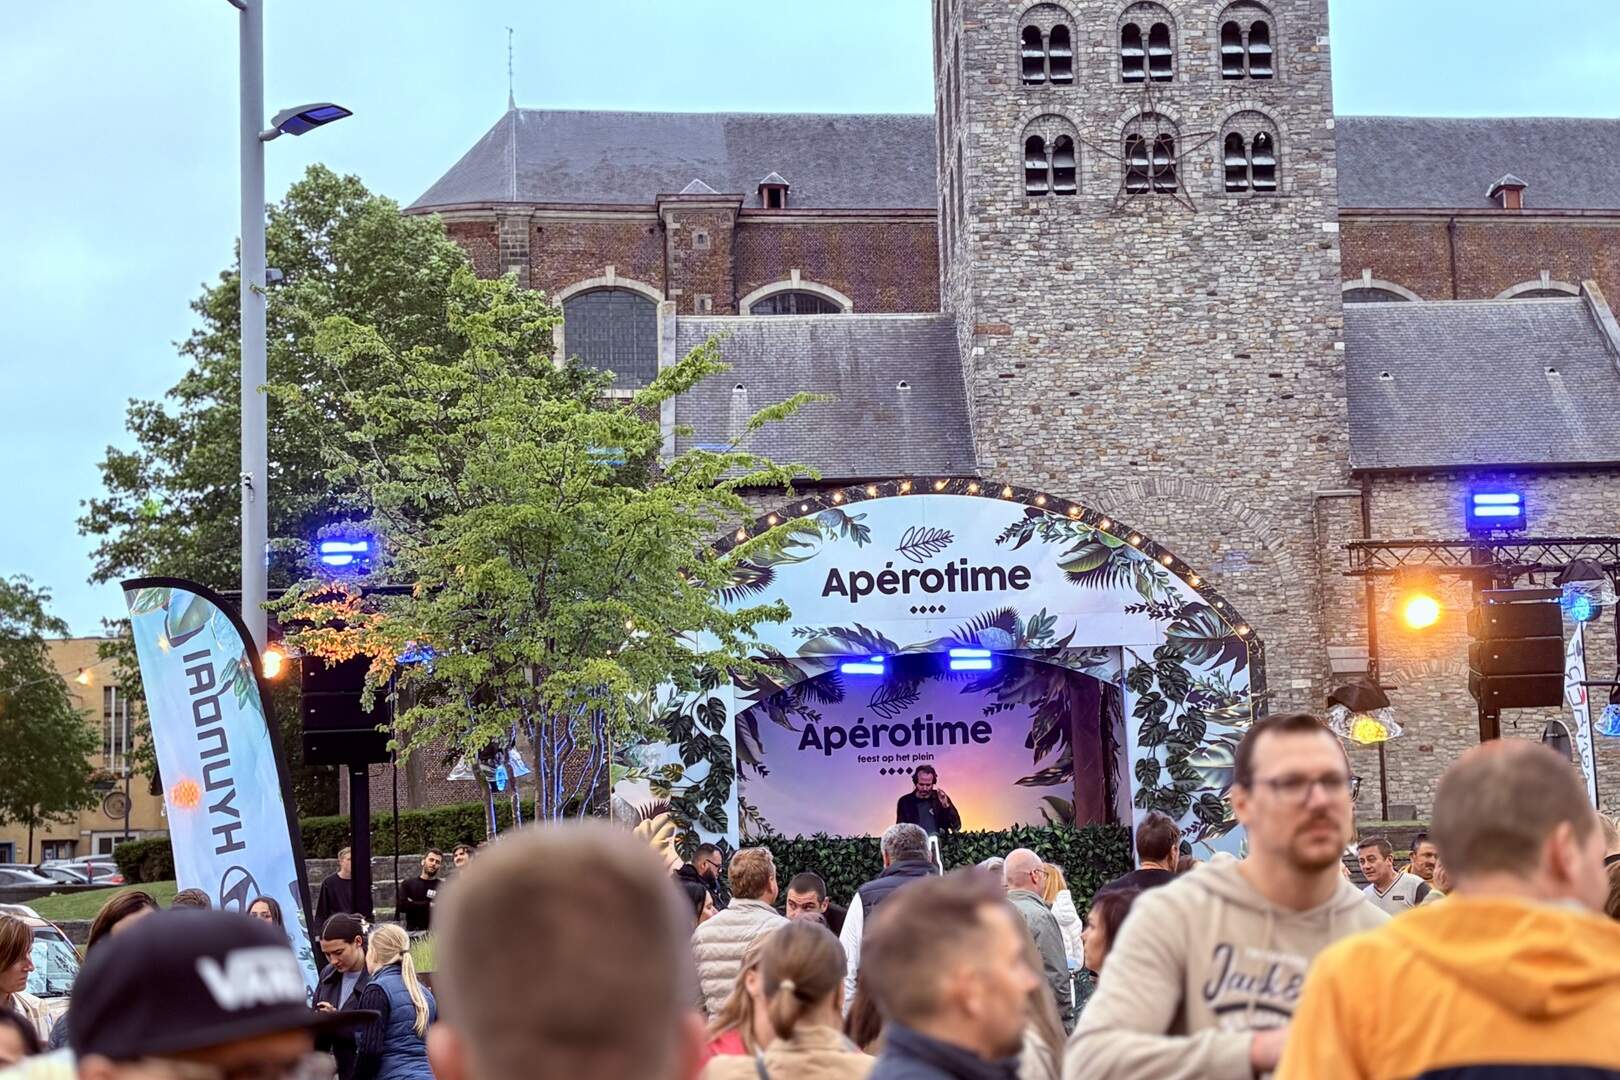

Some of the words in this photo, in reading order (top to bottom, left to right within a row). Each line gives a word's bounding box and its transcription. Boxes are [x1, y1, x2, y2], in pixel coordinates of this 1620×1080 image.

[821, 557, 1031, 603] Apérotime
[798, 714, 992, 756] Apérotime
[857, 754, 880, 763] feest
[883, 755, 894, 764] op
[896, 754, 910, 763] het
[912, 752, 934, 764] plein
